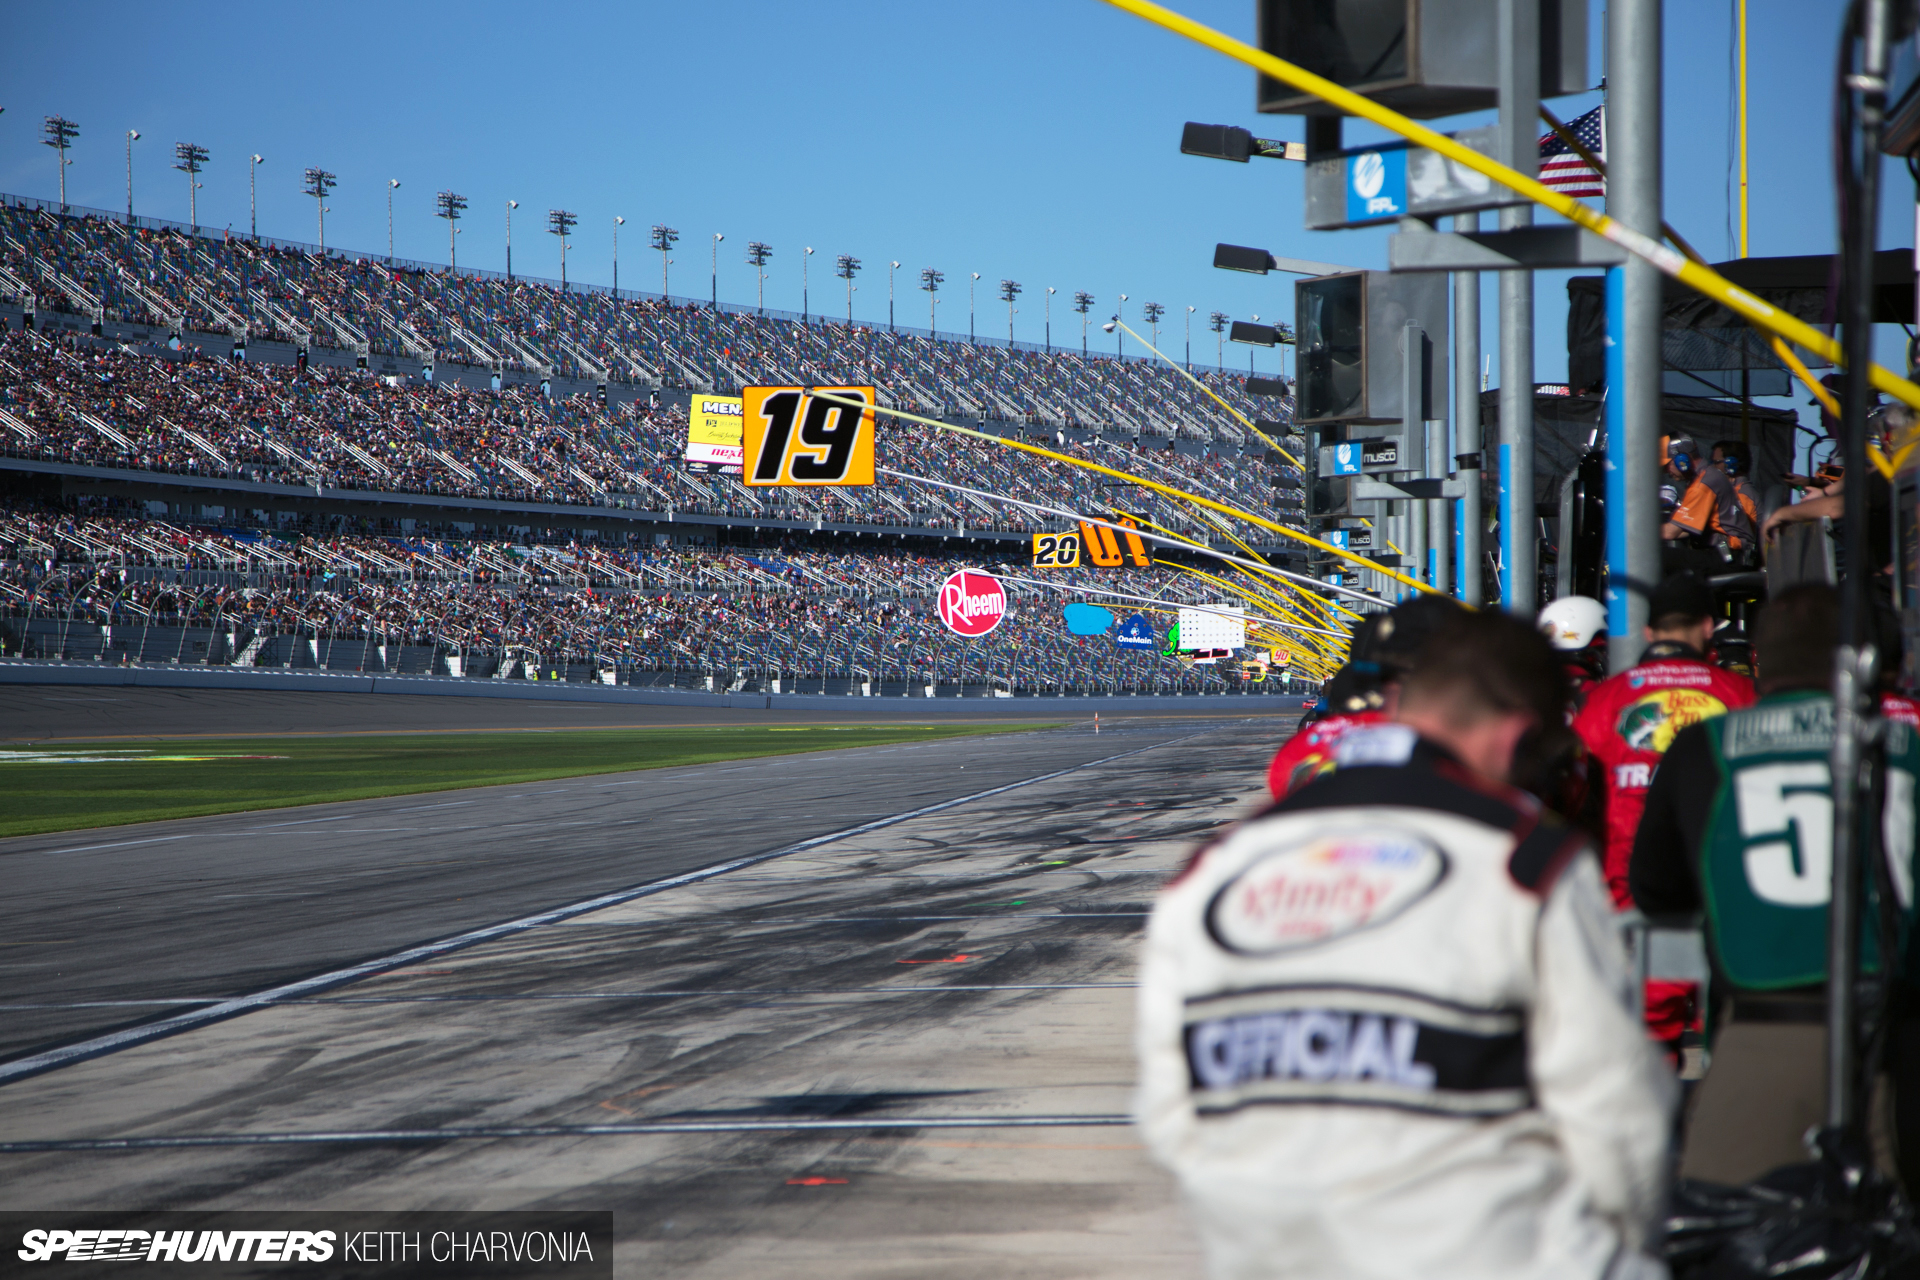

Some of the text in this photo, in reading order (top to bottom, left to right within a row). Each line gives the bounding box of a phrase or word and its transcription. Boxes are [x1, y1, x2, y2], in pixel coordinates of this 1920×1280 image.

[702, 401, 743, 416] MEN
[751, 390, 868, 483] 19
[1035, 535, 1078, 566] 20
[945, 572, 1003, 627] Rheem
[1117, 634, 1153, 645] OneMain
[1192, 1008, 1437, 1090] OFFICIAL
